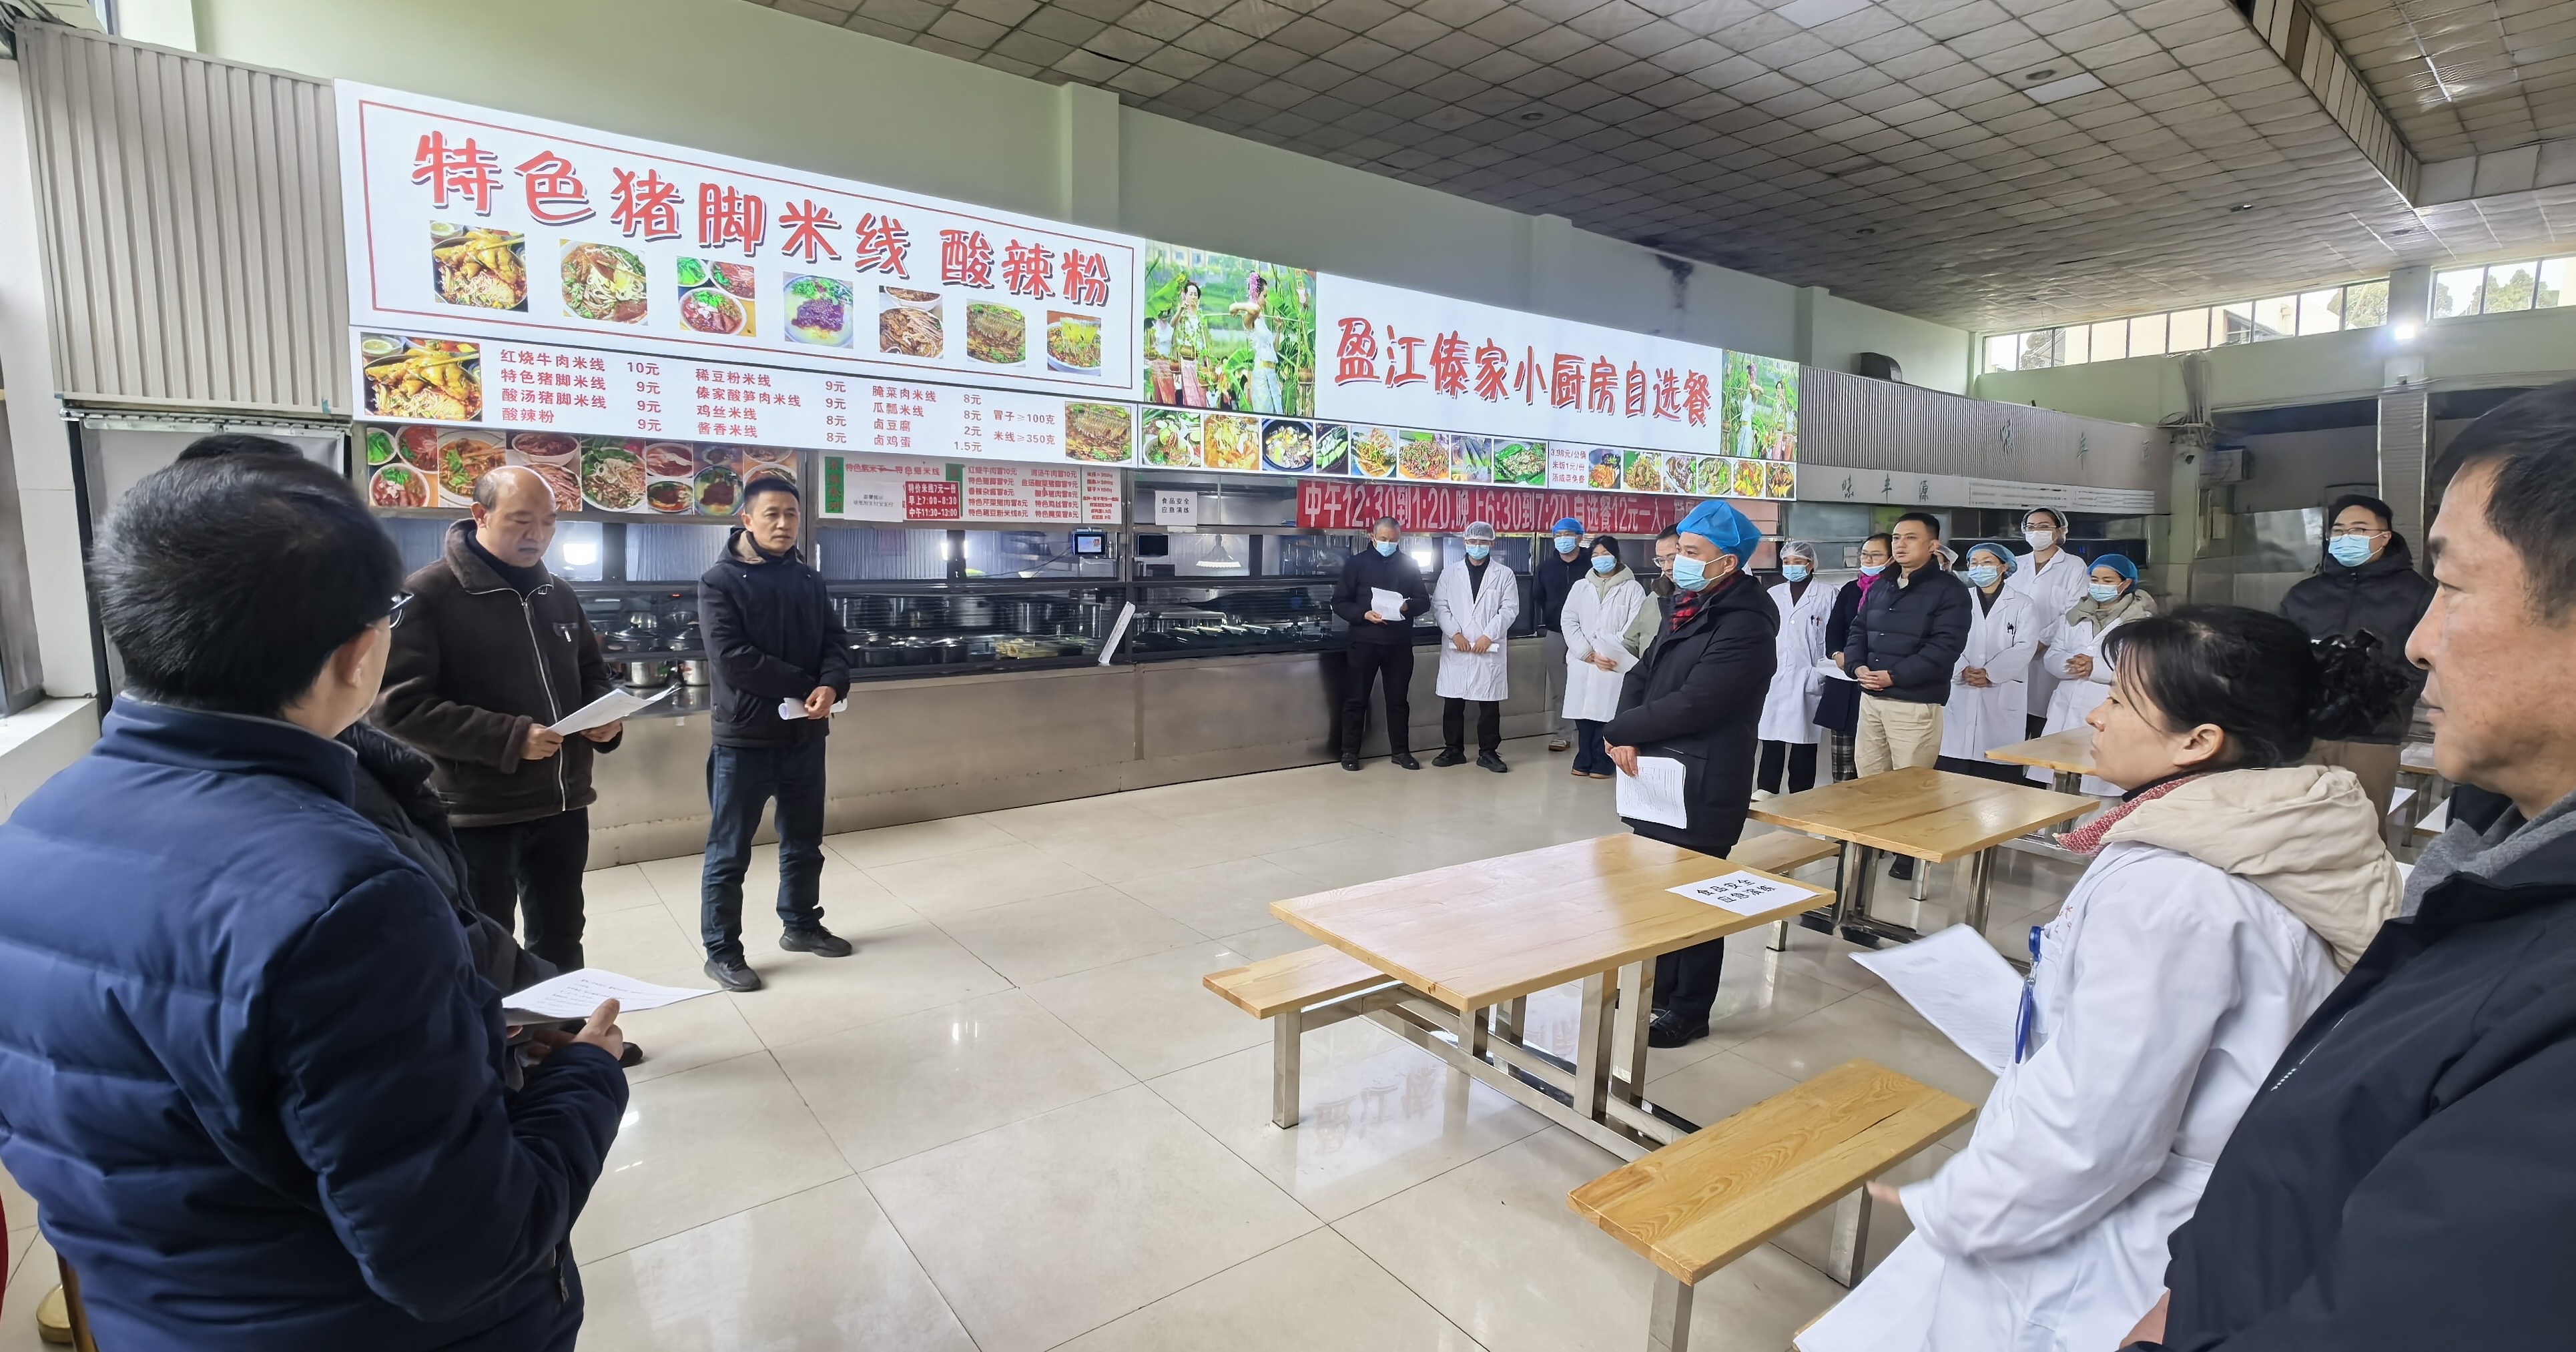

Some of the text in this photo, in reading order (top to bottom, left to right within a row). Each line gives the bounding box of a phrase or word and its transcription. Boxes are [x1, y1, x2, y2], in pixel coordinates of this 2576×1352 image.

[411, 131, 1110, 307] 特色猪脚米线 酸辣粉
[501, 349, 660, 376] 红烧牛肉米线 10元
[1335, 317, 1712, 427] 盈江傣家小厨房自选餐
[501, 368, 661, 394] 特色猪脚米线 9元
[695, 368, 846, 392] 稀豆粉米线 9元
[502, 388, 661, 413] 酸汤猪脚米线 9元
[696, 386, 846, 410] 傣家酸笋肉米线 9元
[872, 386, 982, 405] 腌菜肉米线 8元
[502, 408, 662, 432] 酸辣粉 9元
[697, 404, 847, 427] 鸡丝米线 8元
[874, 418, 982, 436] 卤豆腐 2元
[964, 410, 982, 421] 8元
[698, 422, 847, 444] 酱香米线 8元
[874, 434, 982, 452] 卤鸡蛋 1.5元
[908, 496, 958, 506] 早上7:00-8:30
[1161, 506, 1189, 514] 应急演练
